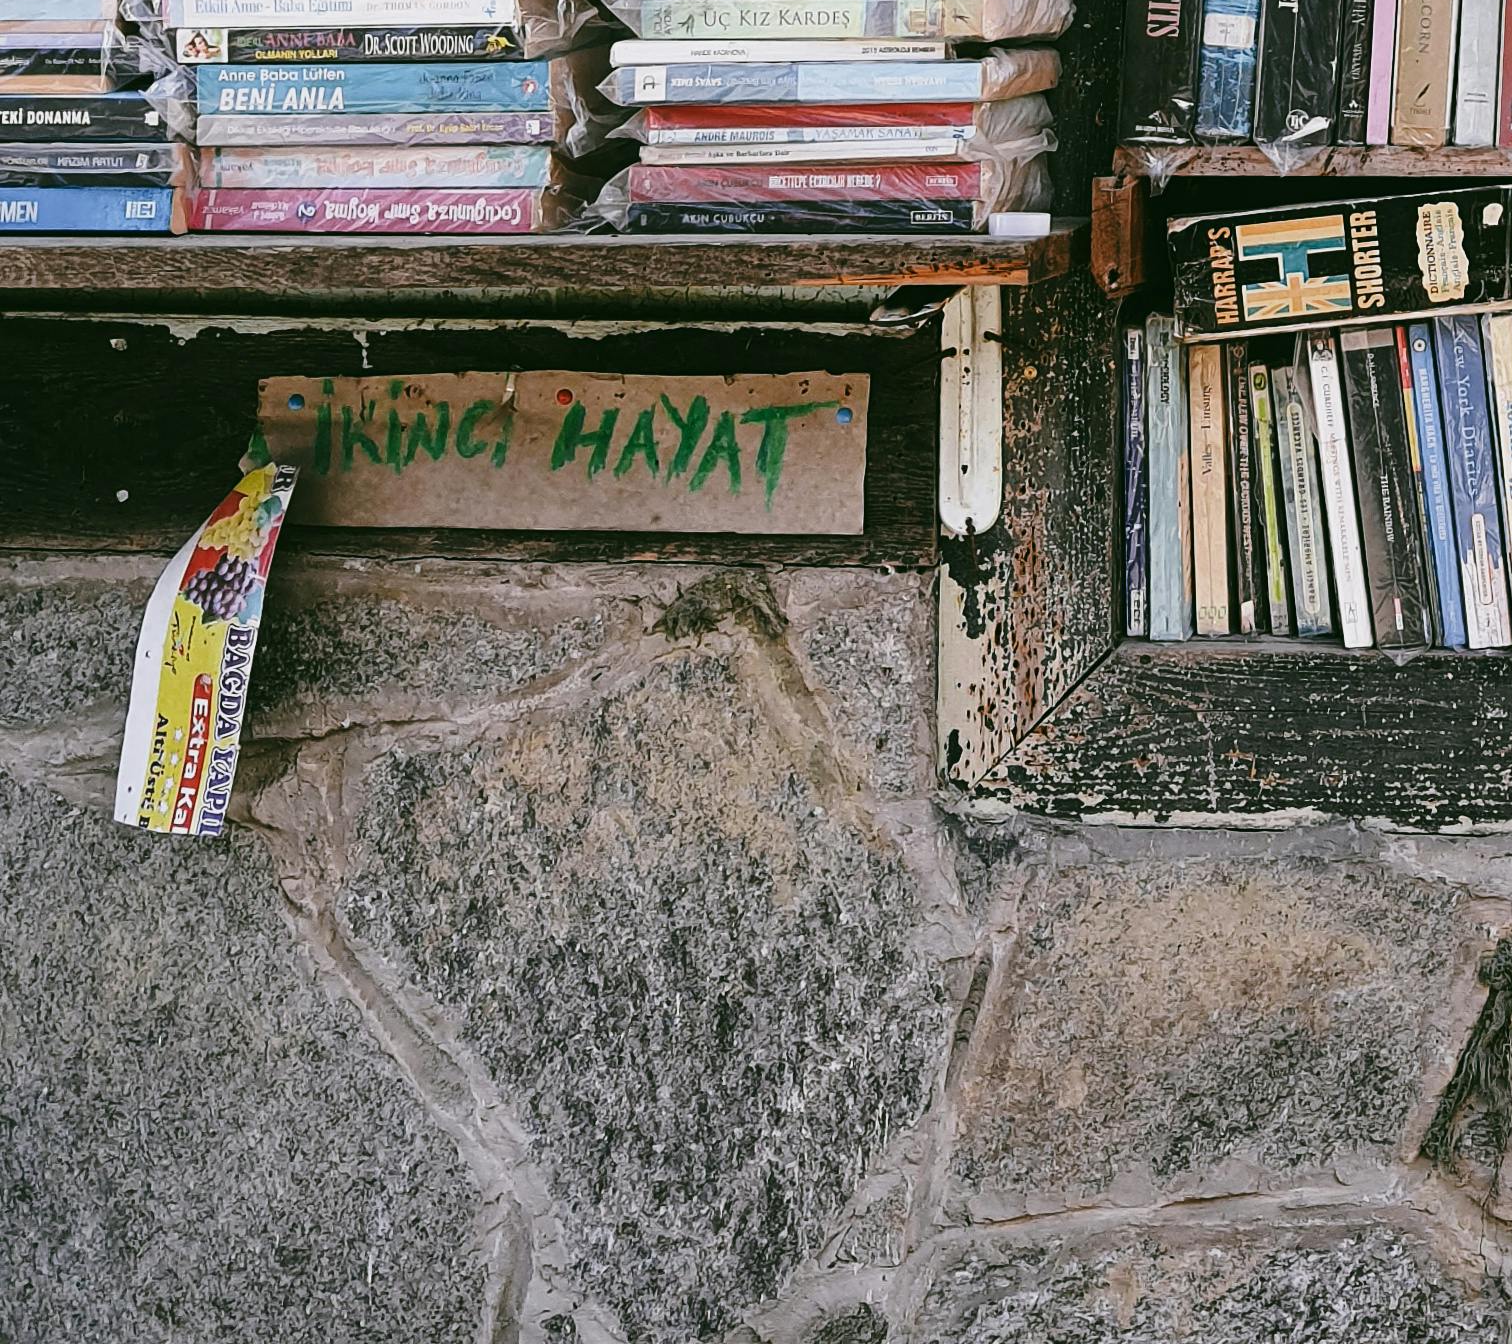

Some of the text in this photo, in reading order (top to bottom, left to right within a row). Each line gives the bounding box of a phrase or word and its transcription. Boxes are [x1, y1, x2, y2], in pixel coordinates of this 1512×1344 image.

[195, 0, 230, 14] Etkili
[233, 0, 263, 14] Anne
[739, 9, 851, 28] KIZ KARDEŞ
[385, 35, 418, 55] SCOTT
[420, 34, 474, 54] WOODING
[218, 68, 345, 84] Anne Baba Lütfen
[219, 82, 344, 112] BENİ ANLA
[27, 111, 90, 125] DONANMA
[729, 131, 775, 141] MAUROIS
[386, 202, 420, 224] Sınır
[426, 201, 521, 226] Çocuğunuza
[1350, 210, 1385, 310] SHORTER
[1421, 210, 1440, 294] DICTIONNAIRE
[1208, 226, 1240, 325] HARRAP'S
[1453, 331, 1480, 496] New York Diaries
[551, 393, 841, 514] HAYAT
[1381, 474, 1395, 543] THE RAINBOW
[183, 696, 209, 780] Extra
